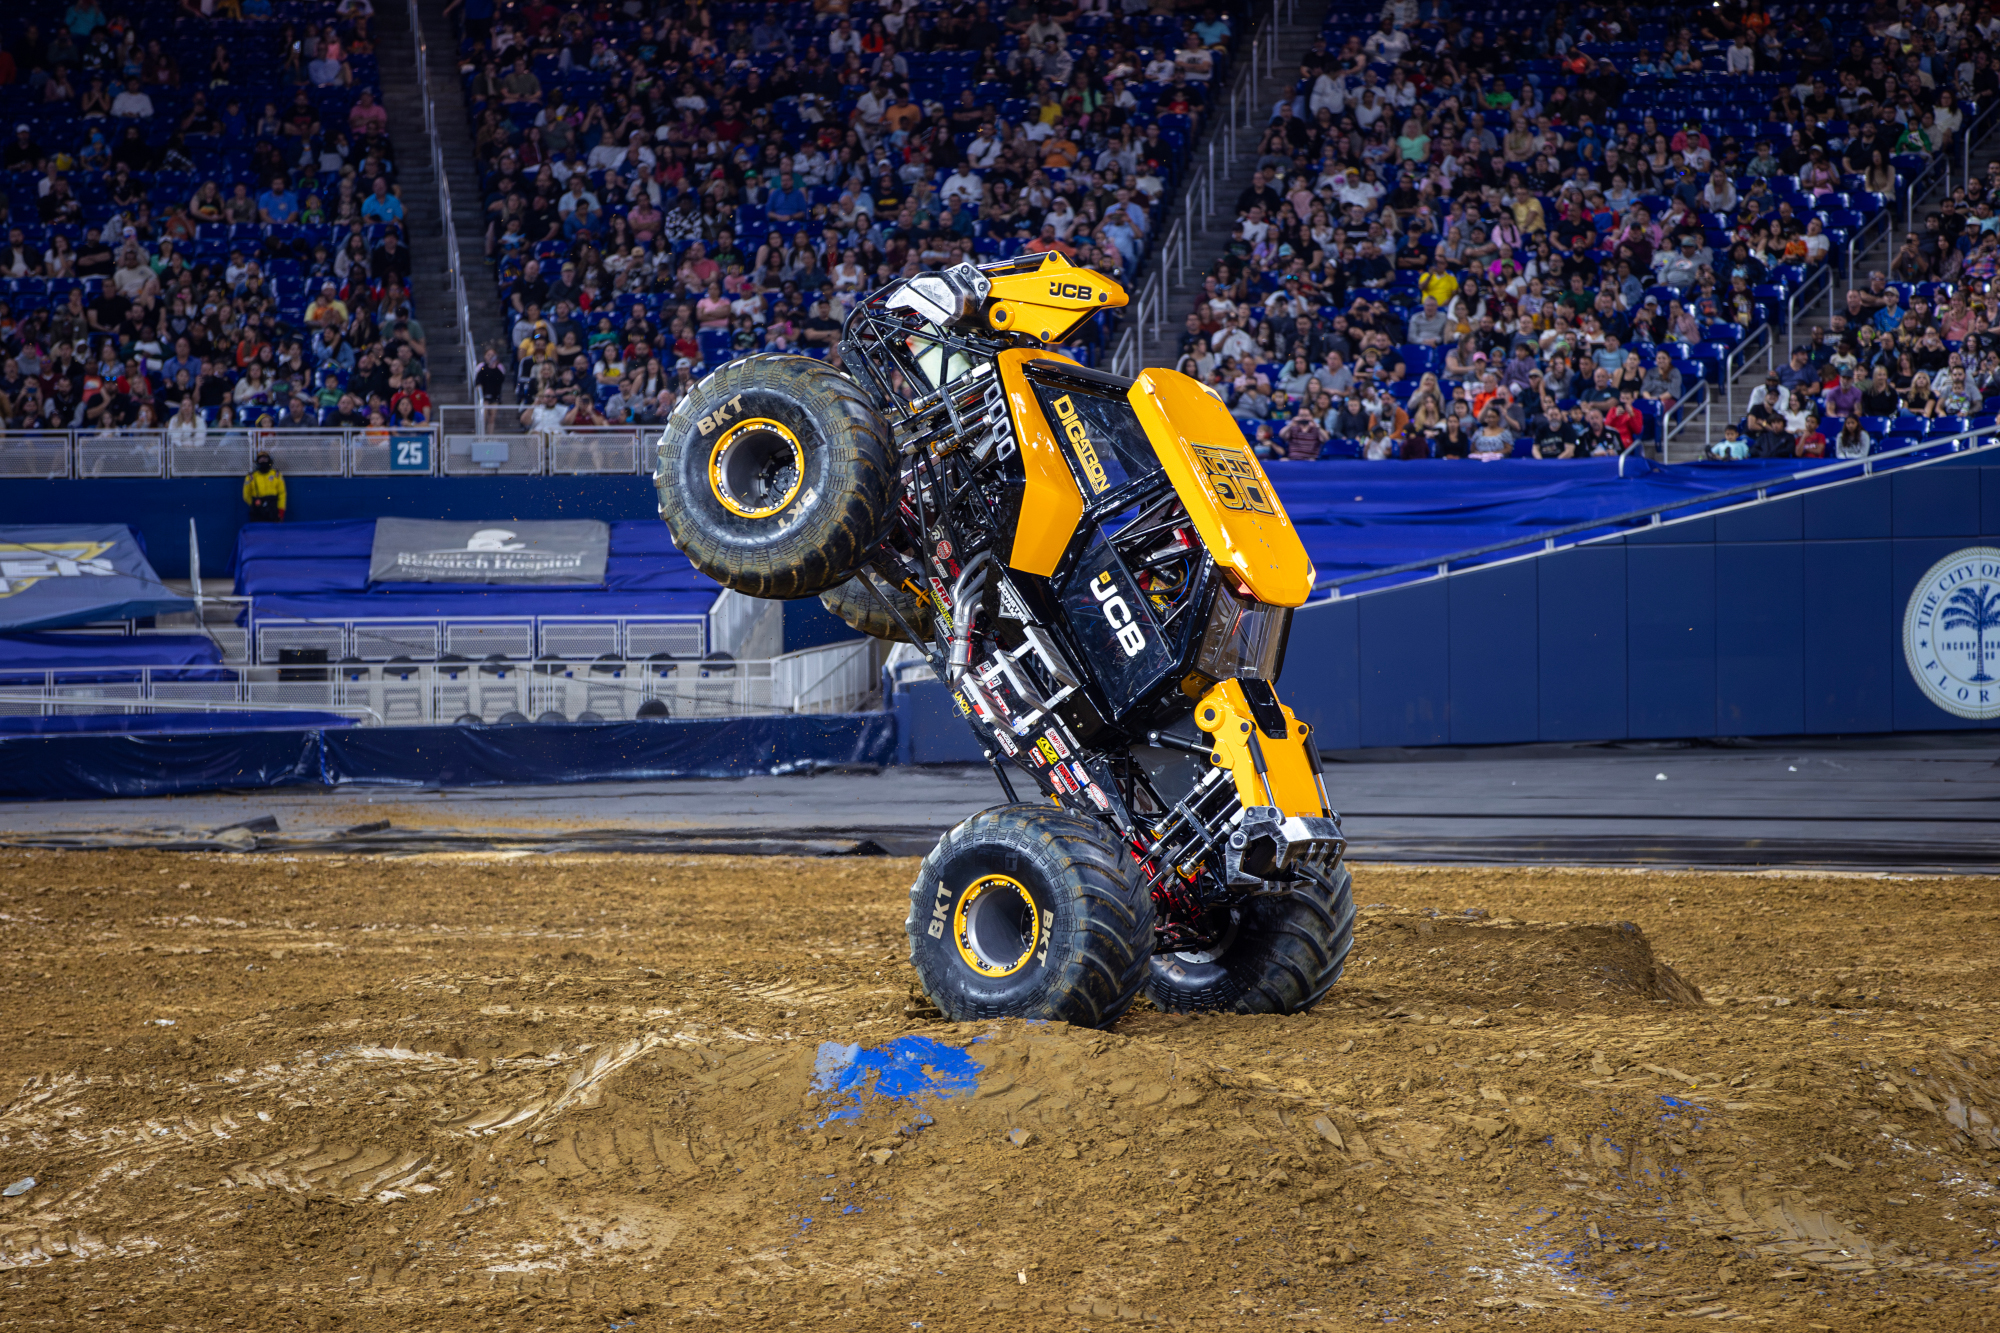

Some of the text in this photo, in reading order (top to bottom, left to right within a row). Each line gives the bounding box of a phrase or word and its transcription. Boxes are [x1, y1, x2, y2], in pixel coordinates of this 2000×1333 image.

[1049, 281, 1092, 301] JCB
[696, 394, 742, 436] BKT
[397, 442, 422, 465] 25
[1053, 394, 1111, 495] DIGATRON
[777, 486, 818, 529] BKT
[397, 556, 489, 569] Research
[494, 555, 582, 571] Hospital
[947, 559, 961, 578] MS
[931, 578, 953, 607] ARP
[996, 581, 1028, 625] MONSTER
[1918, 591, 1940, 629] THE
[1938, 563, 1975, 592] CITY
[1001, 597, 1018, 618] JAM
[1089, 571, 1146, 657] JCB
[937, 616, 951, 638] Holley
[1925, 660, 2000, 703] FLOR
[1032, 747, 1044, 765] Coan
[1047, 731, 1067, 756] SIMPSON
[1057, 763, 1079, 792] DERALE
[928, 881, 952, 940] BKT
[1037, 908, 1054, 967] BKT
[1149, 953, 1186, 983] BK
